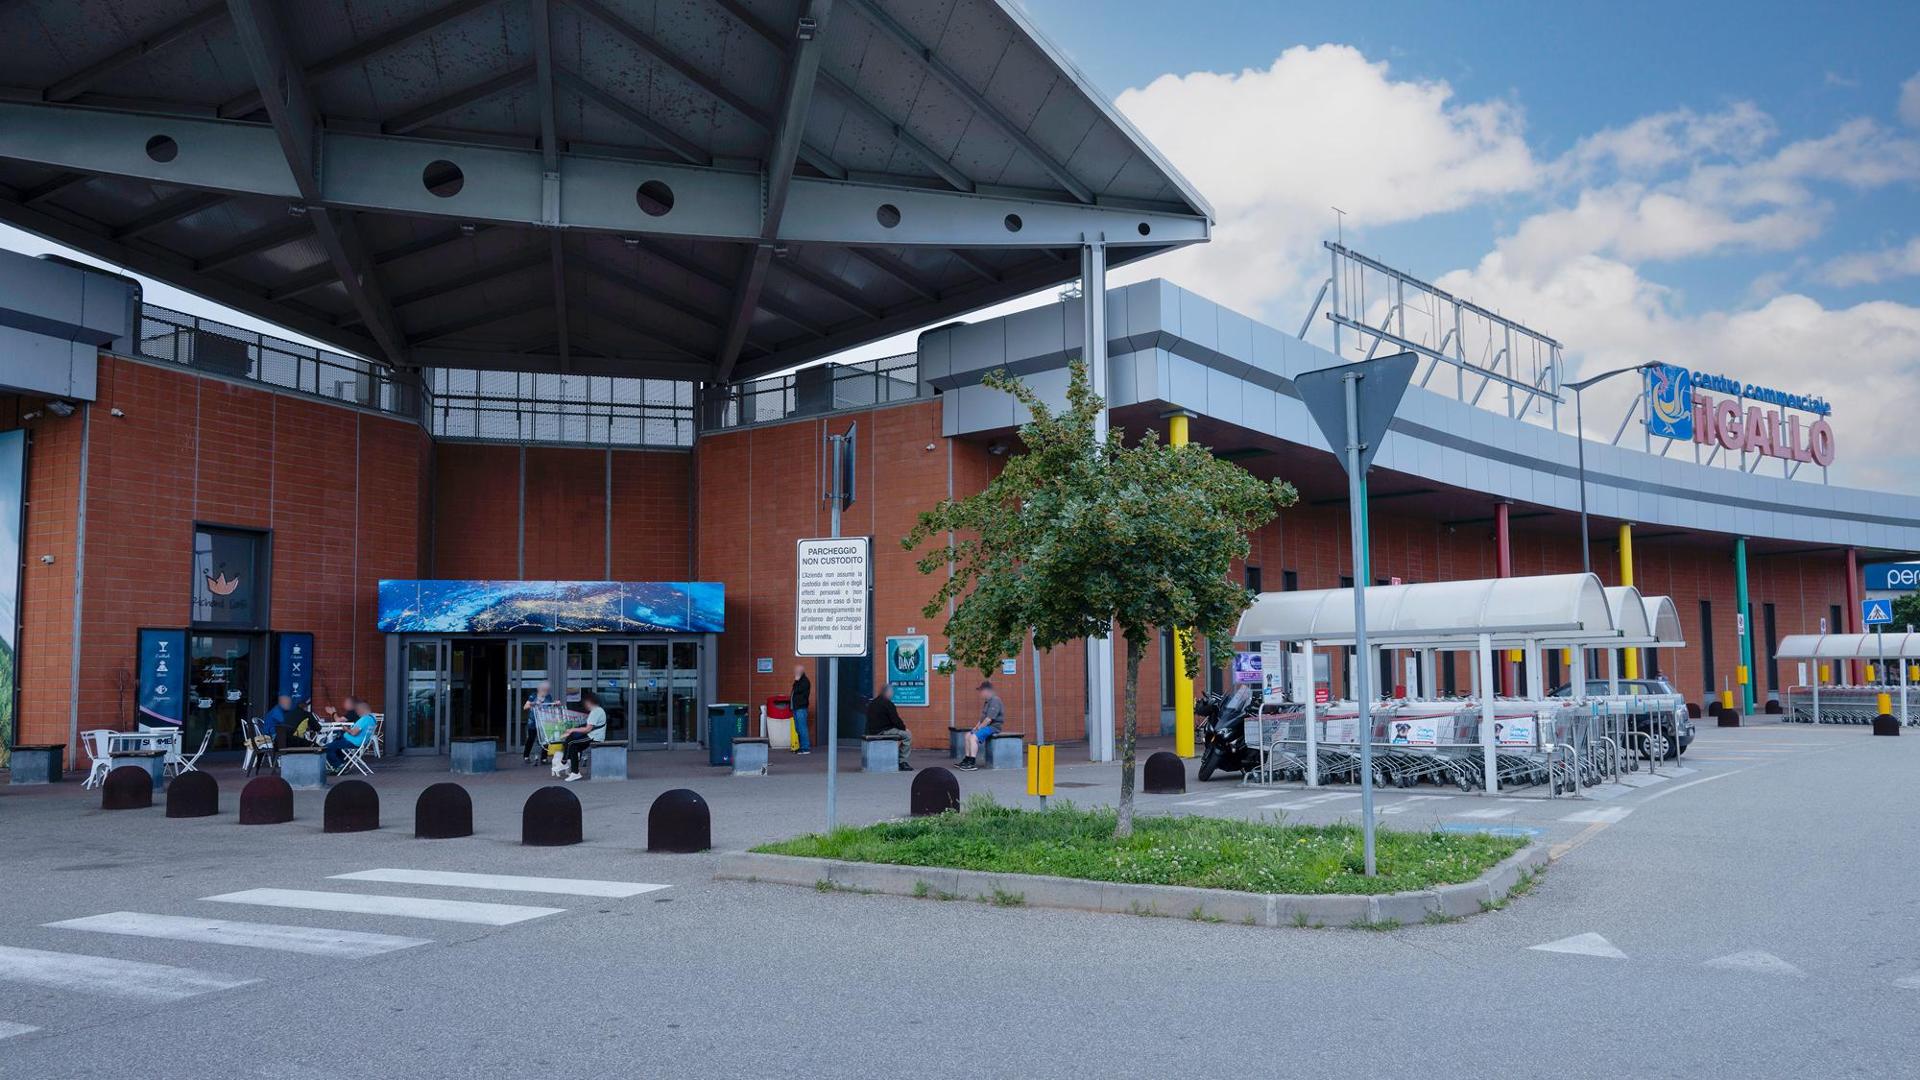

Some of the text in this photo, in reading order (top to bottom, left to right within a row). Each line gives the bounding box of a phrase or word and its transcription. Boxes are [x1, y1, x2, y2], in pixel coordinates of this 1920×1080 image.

[1691, 370, 1831, 416] centro commerciale
[808, 547, 857, 555] PARCHEGGIO
[802, 556, 863, 566] NON CUSTODITO
[1887, 569, 1920, 589] per
[836, 615, 861, 623] parcheggio
[898, 656, 915, 670] DAYS
